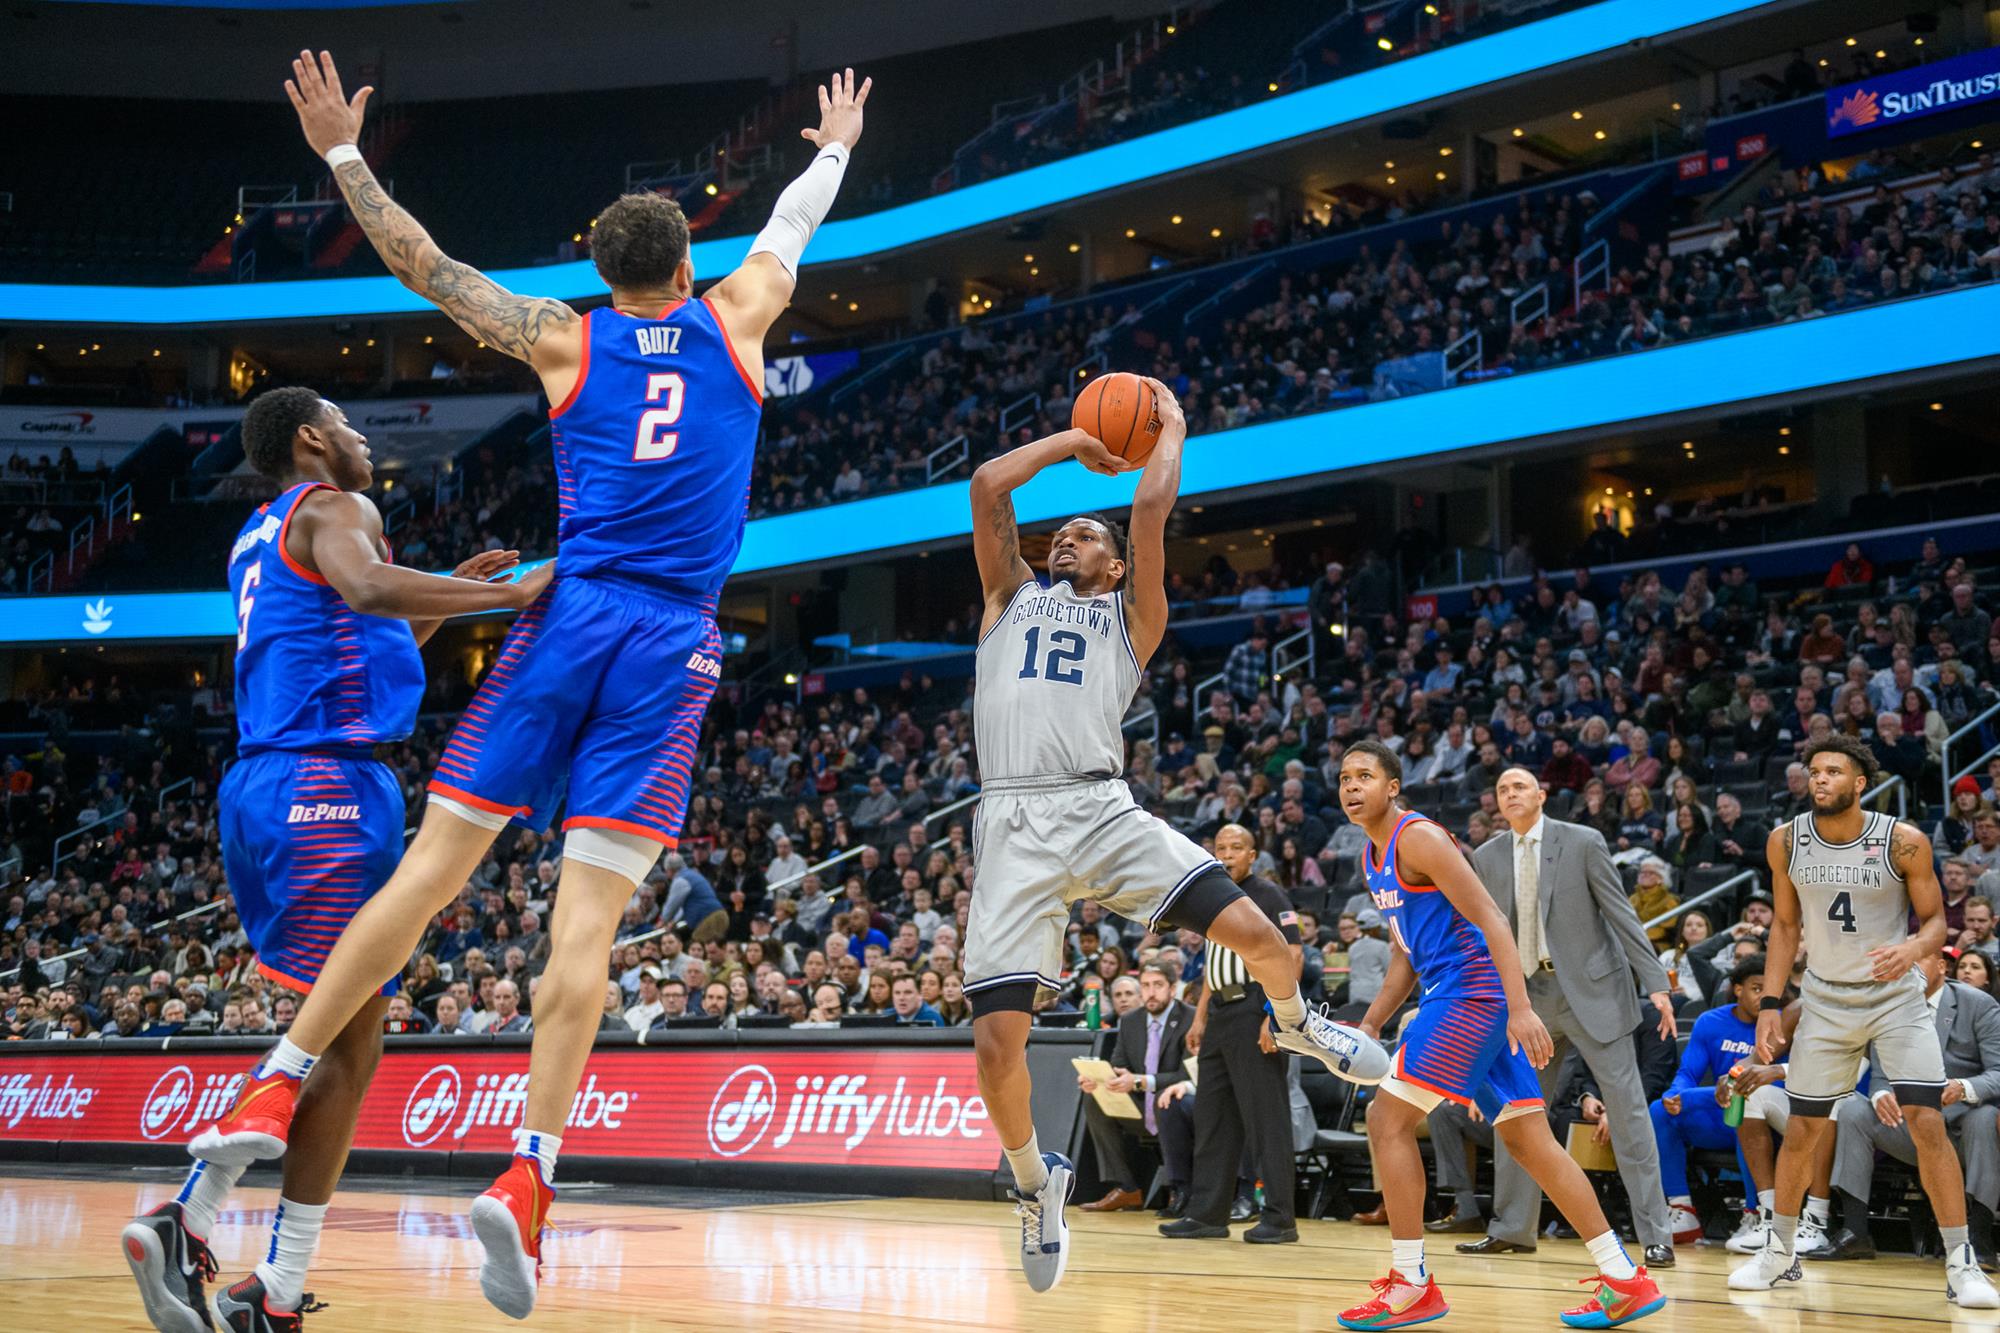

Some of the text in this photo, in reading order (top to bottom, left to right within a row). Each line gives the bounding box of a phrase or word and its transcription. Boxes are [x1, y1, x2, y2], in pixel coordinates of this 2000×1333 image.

[635, 326, 682, 356] BUTZ
[633, 372, 686, 462] 2
[238, 560, 262, 651] 5
[1012, 596, 1112, 639] GEORGETOWN
[686, 652, 722, 679] DEPA
[1017, 625, 1088, 687] 12
[286, 803, 361, 823] DEPAUL
[1797, 865, 1882, 889] GEORGETOWN
[1827, 890, 1858, 933] 4
[1721, 1039, 1755, 1055] DEPA
